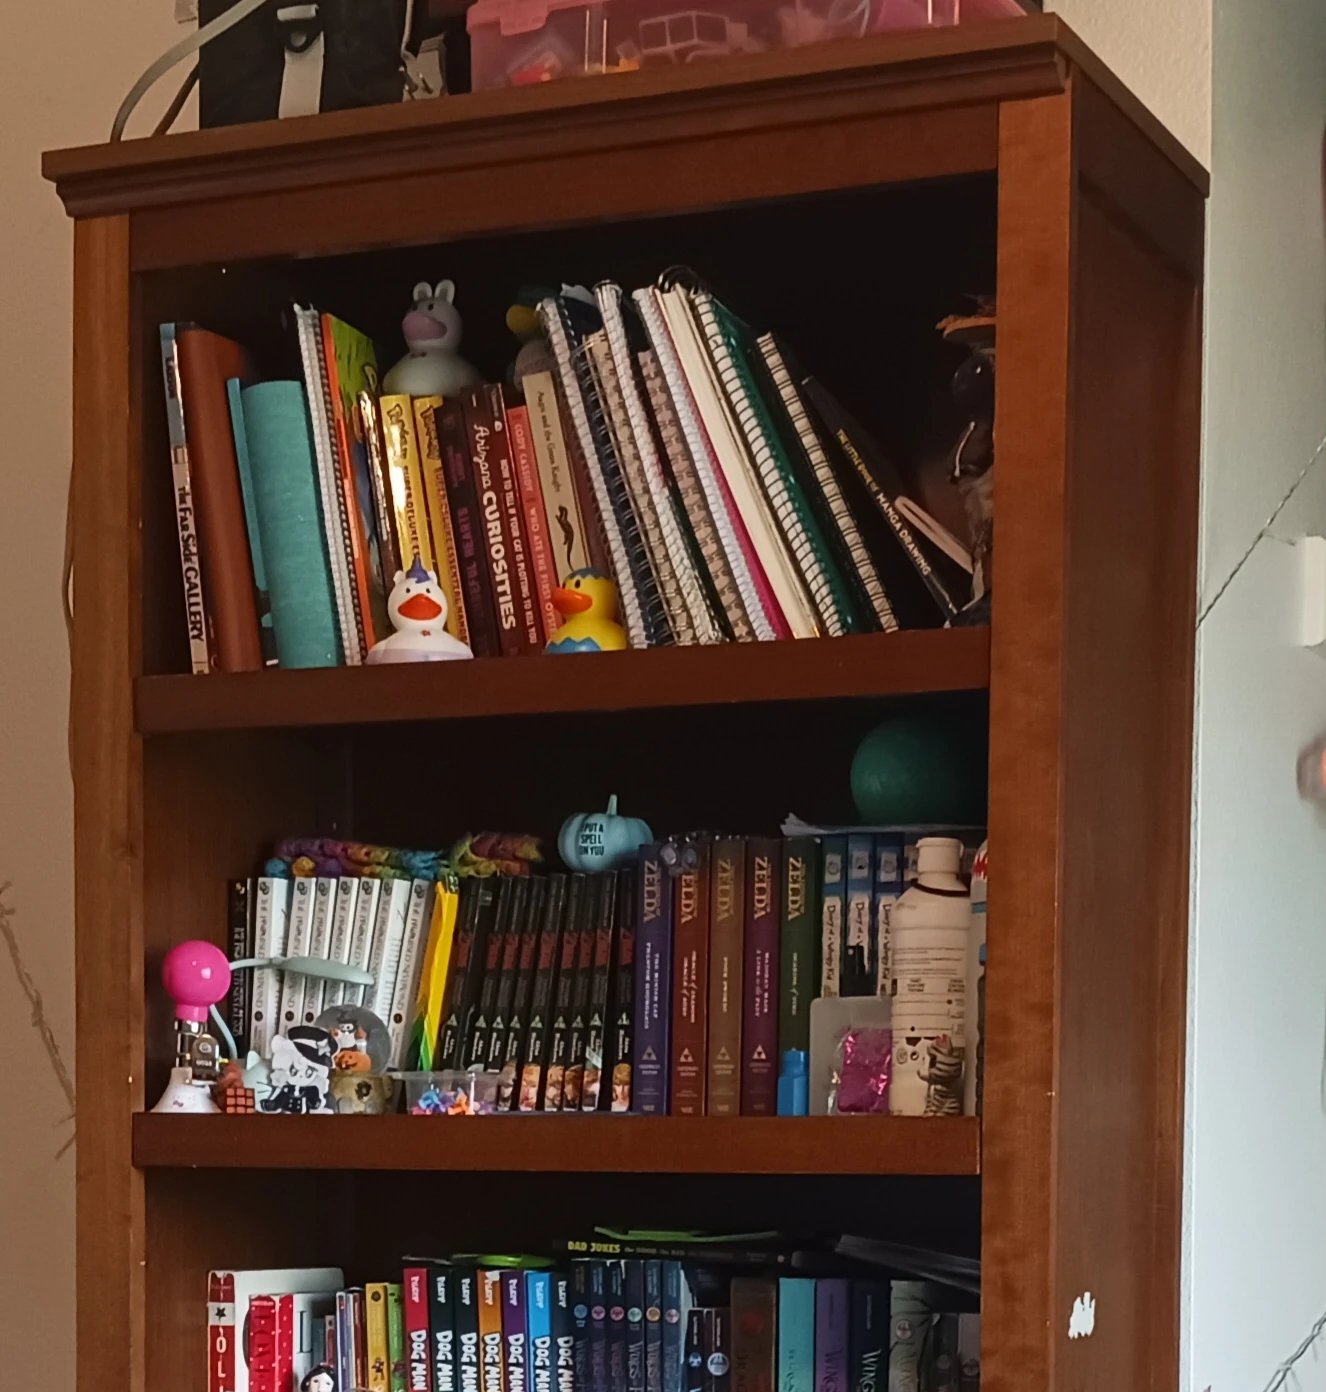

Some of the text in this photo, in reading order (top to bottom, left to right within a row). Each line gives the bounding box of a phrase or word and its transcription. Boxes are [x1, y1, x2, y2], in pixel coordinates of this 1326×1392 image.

[178, 506, 192, 532] FAR
[473, 424, 516, 630] Arizona CURIOSITIES
[510, 517, 519, 537] YOUR
[876, 493, 901, 530] MANGA
[899, 530, 932, 576] DRAWING
[513, 539, 522, 552] CAT
[530, 508, 551, 602] WHO ATE THE FIRST
[517, 562, 530, 598] PLOTTING
[184, 566, 204, 642] GALLERY
[524, 599, 532, 609] TO
[525, 610, 534, 626] KILL
[528, 627, 537, 643] YOU
[580, 834, 602, 844] SPELL
[585, 823, 598, 833] PUT
[590, 846, 605, 856] YOU
[643, 859, 657, 923] ZELDA
[681, 870, 695, 924] ELDA
[717, 859, 730, 922] ZELDA
[754, 857, 768, 920] ZELDA
[788, 857, 801, 921] ZELDA
[567, 1241, 620, 1253] DAD JOKES
[410, 1329, 427, 1391] DOG MAN
[436, 1330, 453, 1361] DOG
[460, 1332, 477, 1363] DOG
[483, 1333, 500, 1363] DOG
[508, 1333, 525, 1364] DOG
[534, 1336, 550, 1367] DOG
[557, 1336, 573, 1366] DOG
[437, 1363, 453, 1392] MAN
